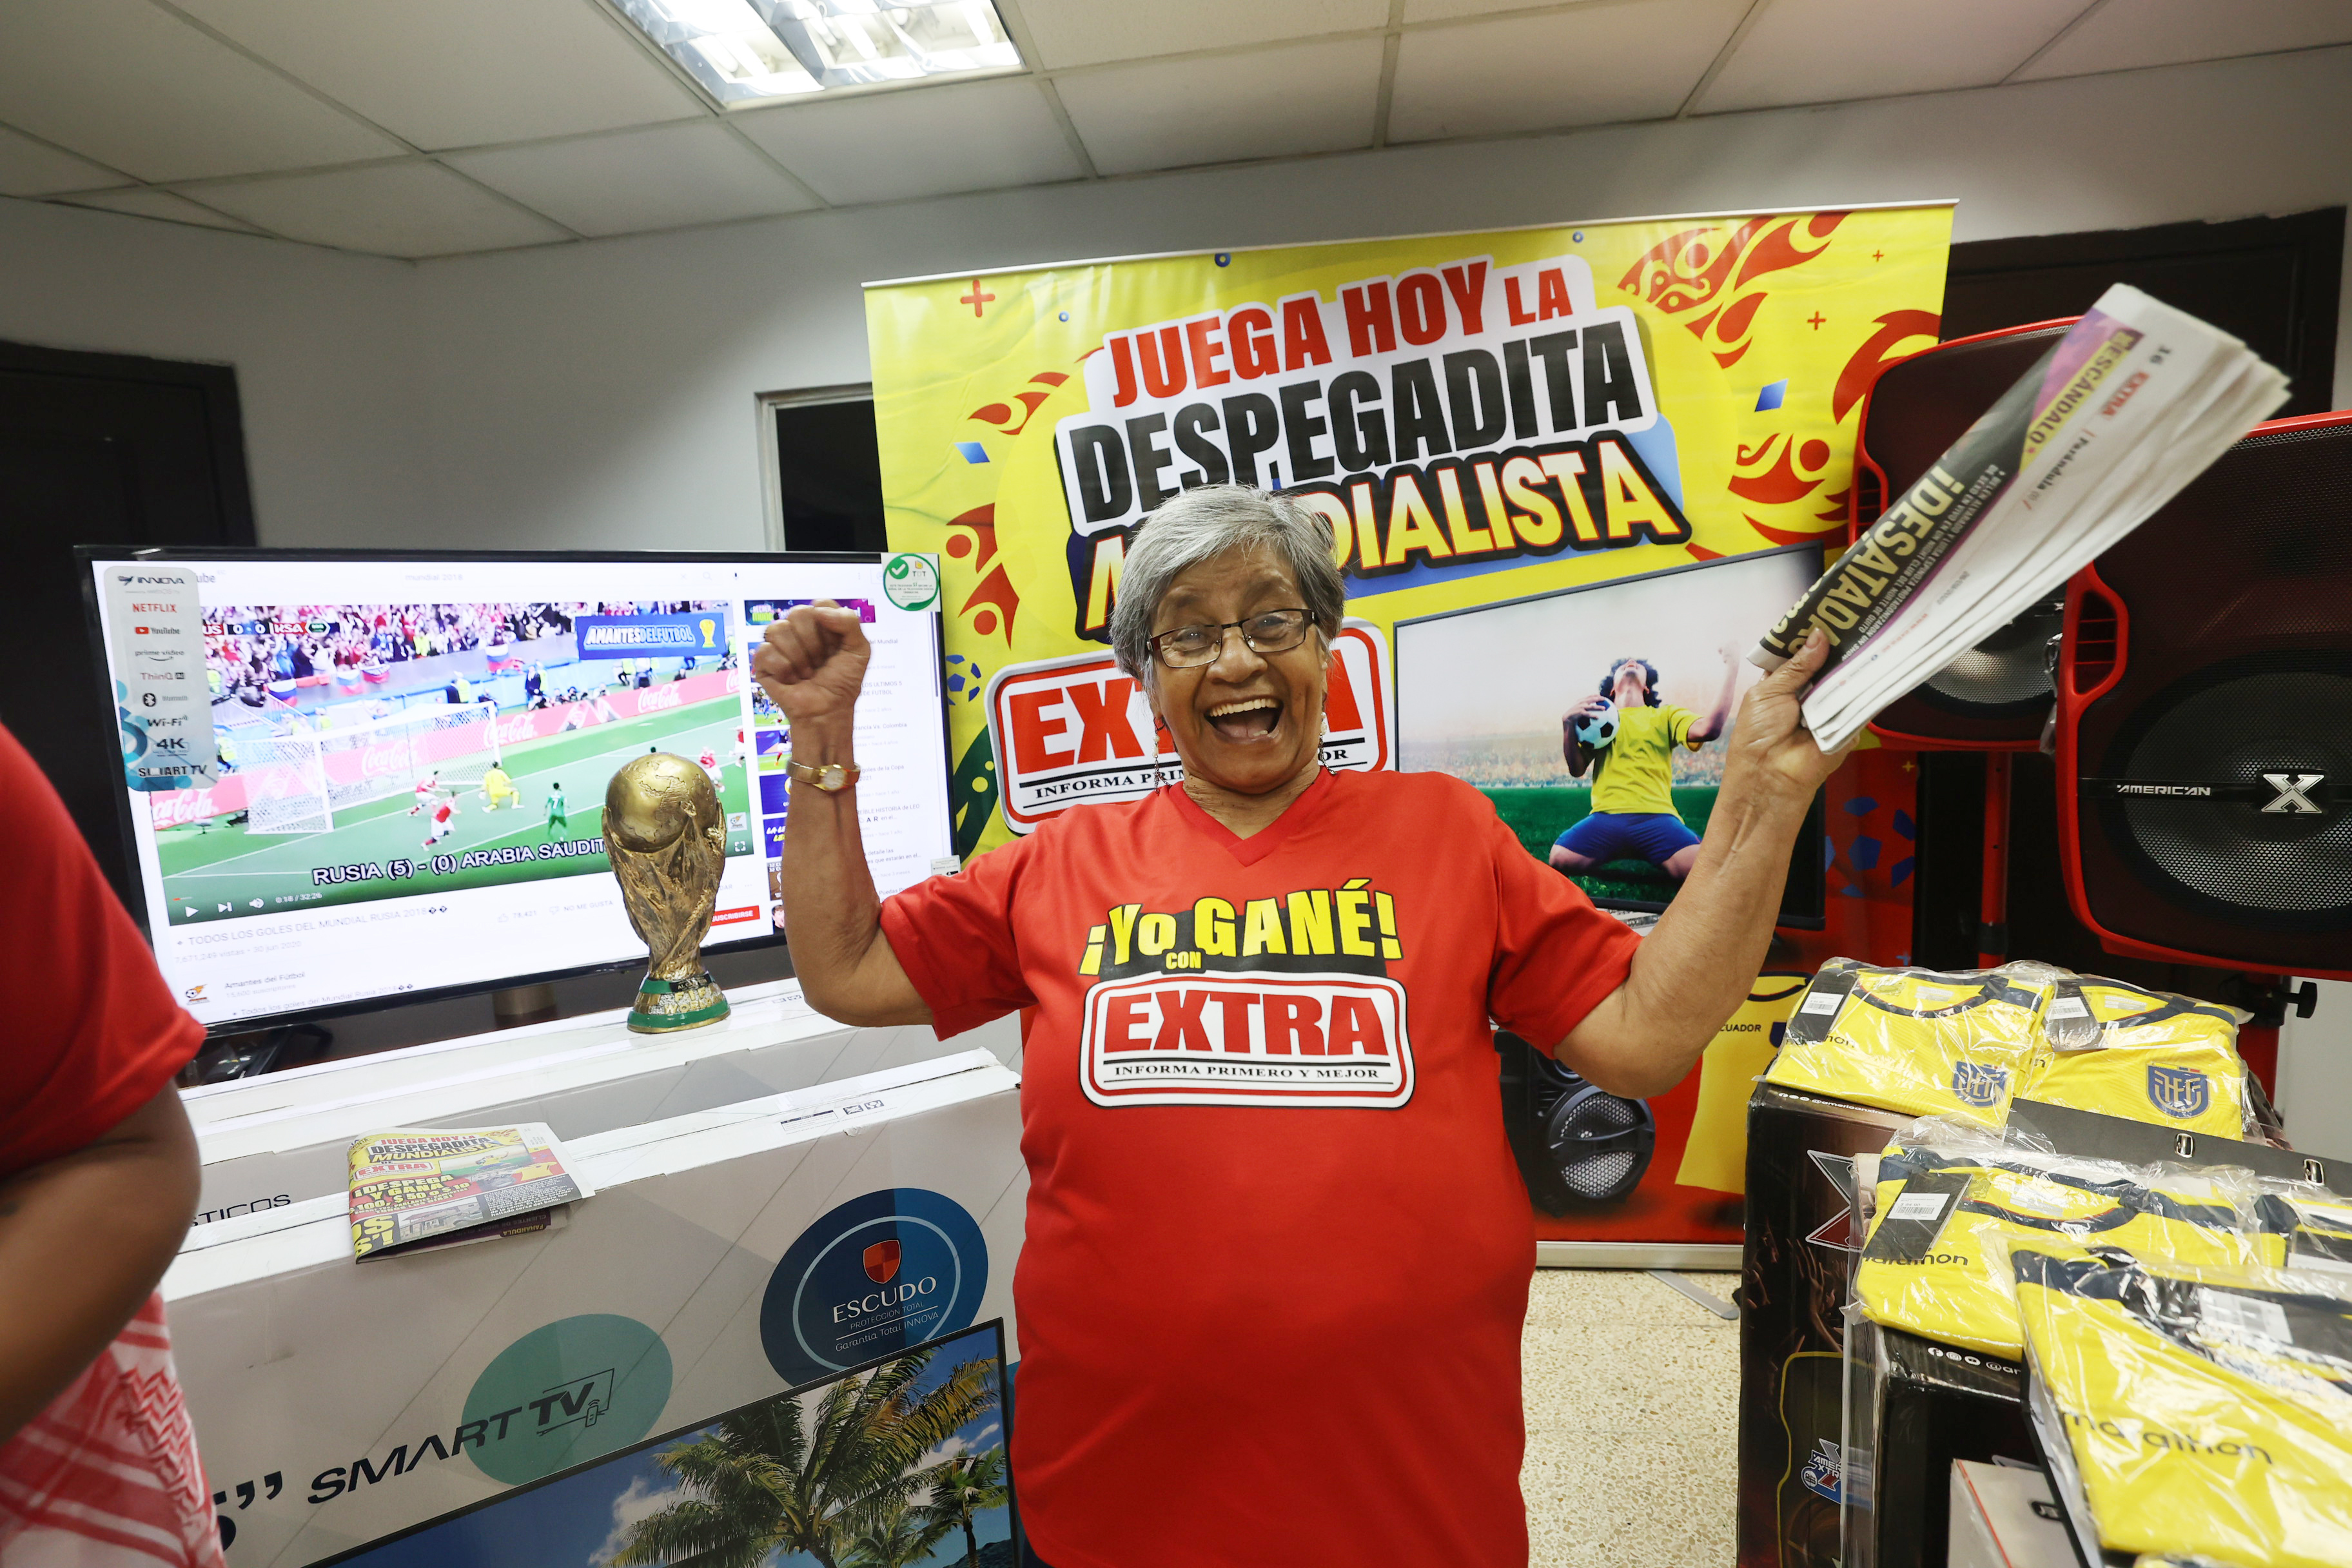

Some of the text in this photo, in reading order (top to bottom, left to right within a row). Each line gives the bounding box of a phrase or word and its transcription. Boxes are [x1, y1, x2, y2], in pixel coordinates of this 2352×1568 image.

[1110, 261, 1574, 409] JUEGA HOY LA
[2101, 369, 2150, 416] EXTRA
[1069, 320, 1643, 524] DESPEGADITA
[1085, 439, 1682, 631] DIALISTA
[132, 603, 177, 613] NETFLIX
[1868, 585, 1912, 637] PROTAGONIZARON
[273, 623, 304, 634] KSA
[1858, 614, 1876, 633] QUITO
[1859, 634, 1868, 645] UN
[1841, 643, 1860, 662] SHOW
[156, 738, 185, 749] 4K
[191, 765, 207, 774] TV
[1035, 775, 1132, 799] INFORMA
[2117, 774, 2325, 813] AMERICAN X
[313, 865, 383, 885] RUSIA
[387, 859, 413, 879] (5)
[431, 855, 456, 874] (0)
[461, 845, 534, 869] ARABIA
[538, 838, 607, 859] SAUDIT
[188, 933, 229, 945] TODOS
[231, 930, 254, 939] LOS
[256, 925, 293, 937] GOLES
[295, 922, 316, 932] DEL
[318, 915, 368, 929] MUNDIAL
[370, 911, 400, 922] RUSIA
[1078, 879, 1403, 975] ¡Yo GANÉ!
[1165, 950, 1202, 970] CON
[224, 978, 262, 989] Amantes
[264, 975, 277, 984] del
[1104, 990, 1389, 1056] EXTRA
[1115, 1066, 1380, 1079] INFORMA PRIMERO Y MEJOR
[371, 1137, 490, 1154] DESPEGADITA
[381, 1137, 429, 1145] JUEGA
[372, 1142, 498, 1162] MUNDIALISTA
[358, 1163, 427, 1175] EXTRA
[354, 1174, 454, 1197] ¡DESPEGA
[370, 1183, 444, 1200] Y GANA
[832, 1277, 937, 1324] ESCUDO
[902, 1300, 925, 1317] TOTAL
[880, 1325, 902, 1337] Total
[904, 1311, 939, 1329] INNOVA
[308, 1382, 595, 1505] SMART TV
[2063, 1412, 2273, 1465] maathon
